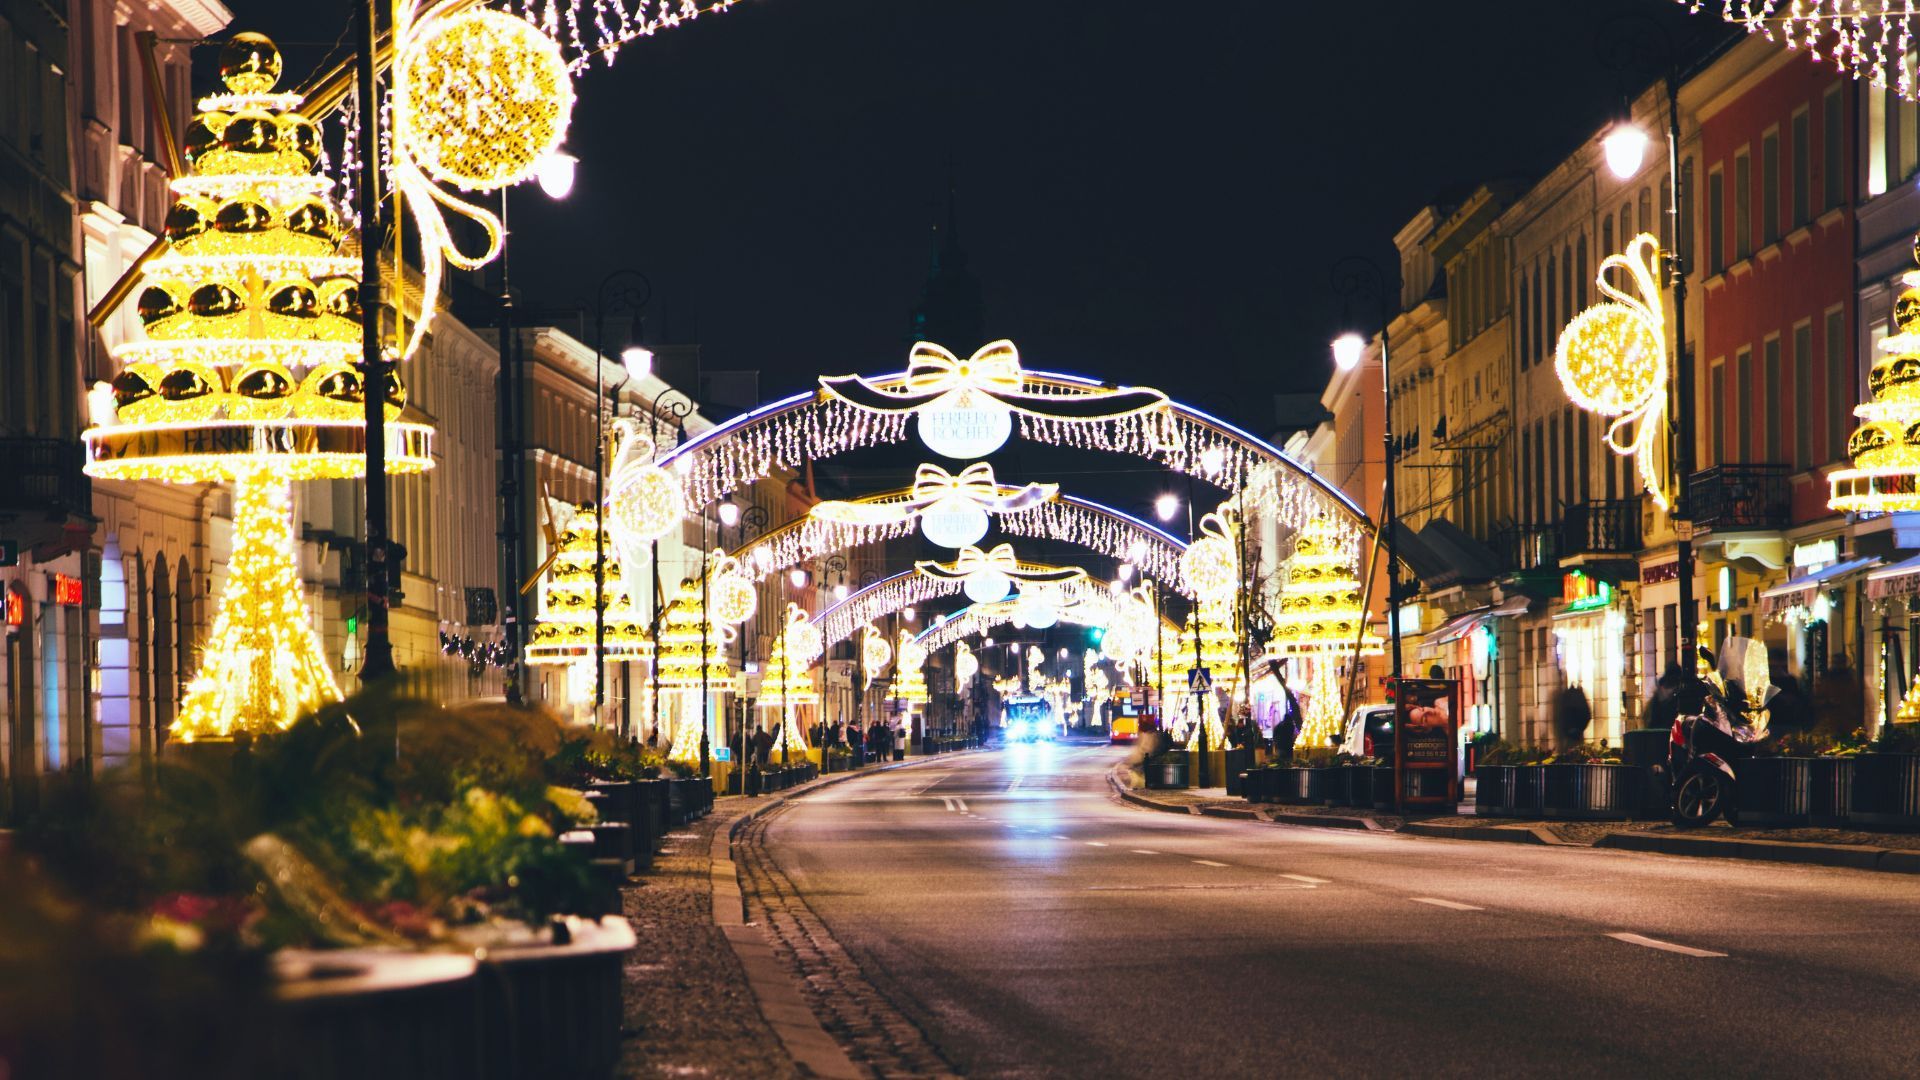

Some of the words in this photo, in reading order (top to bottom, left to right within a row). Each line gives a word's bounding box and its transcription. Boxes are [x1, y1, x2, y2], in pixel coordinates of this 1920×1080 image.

[932, 411, 997, 425] FERRERO
[184, 425, 297, 450] FERRERO
[932, 426, 996, 440] ROCHER
